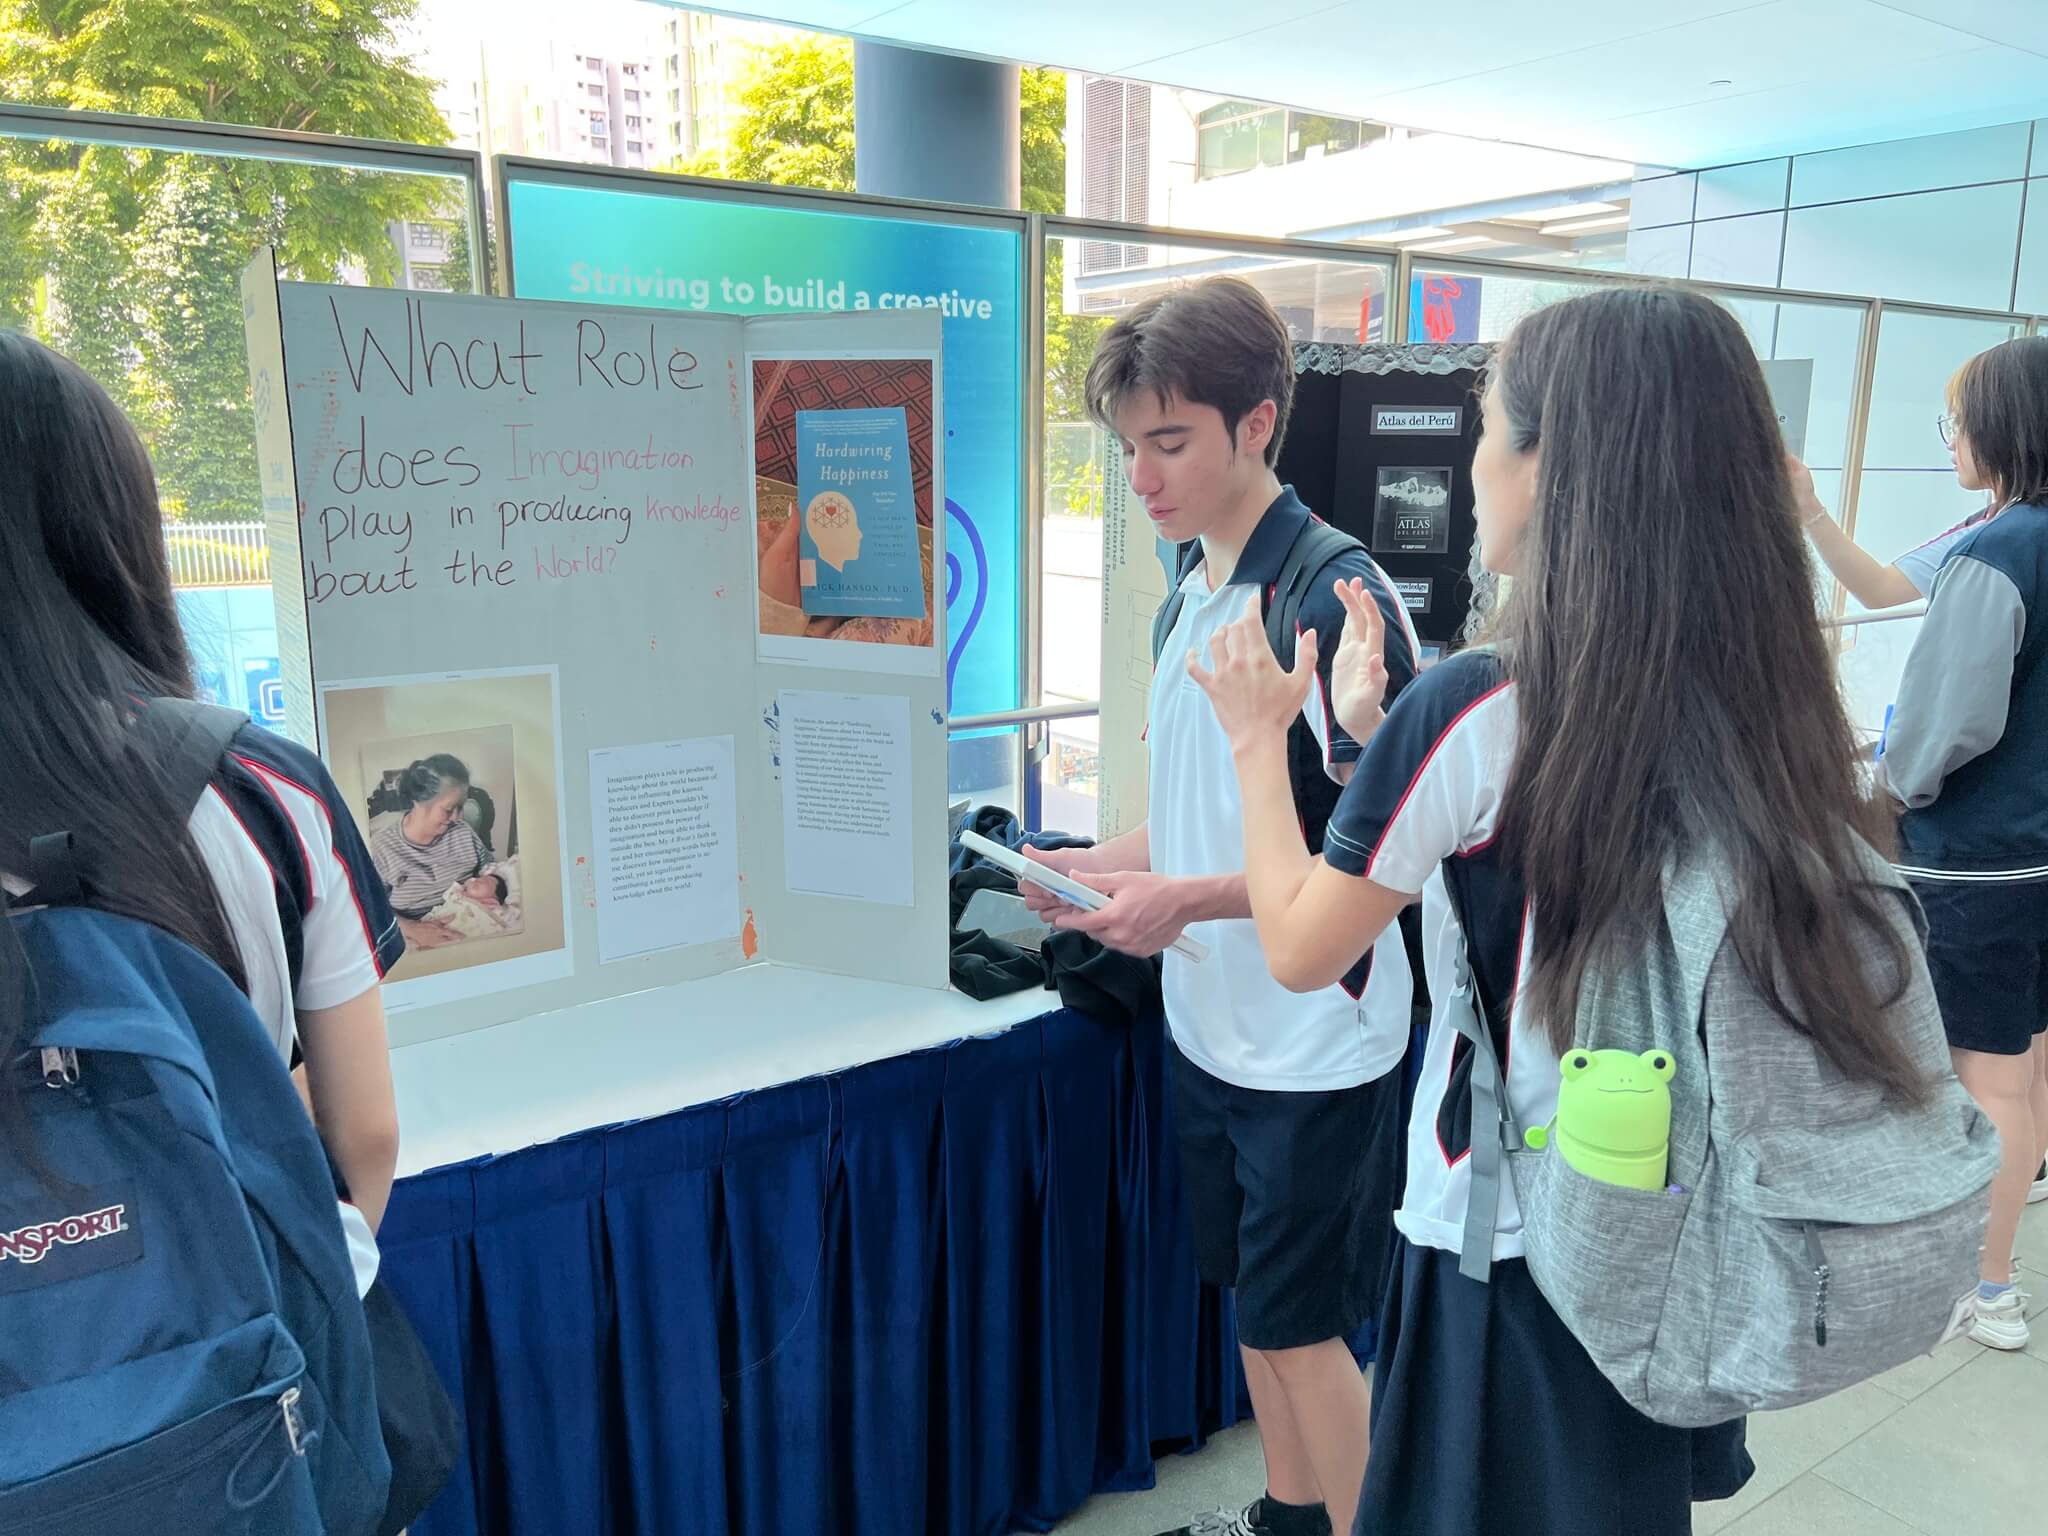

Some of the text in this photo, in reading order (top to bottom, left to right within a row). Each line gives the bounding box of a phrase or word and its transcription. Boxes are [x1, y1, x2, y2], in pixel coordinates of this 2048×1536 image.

[569, 262, 992, 319] Striving to build a creative
[329, 296, 703, 396] What Role
[1378, 413, 1454, 427] Atlas del Perú
[333, 416, 694, 494] does Imagination
[815, 443, 892, 461] Hardwiring
[821, 465, 889, 485] Happiness
[320, 504, 413, 563] play
[451, 504, 473, 530] in
[499, 494, 632, 549] producing
[1398, 520, 1430, 529] ATLAS
[305, 556, 417, 603] bout
[444, 550, 516, 586] the
